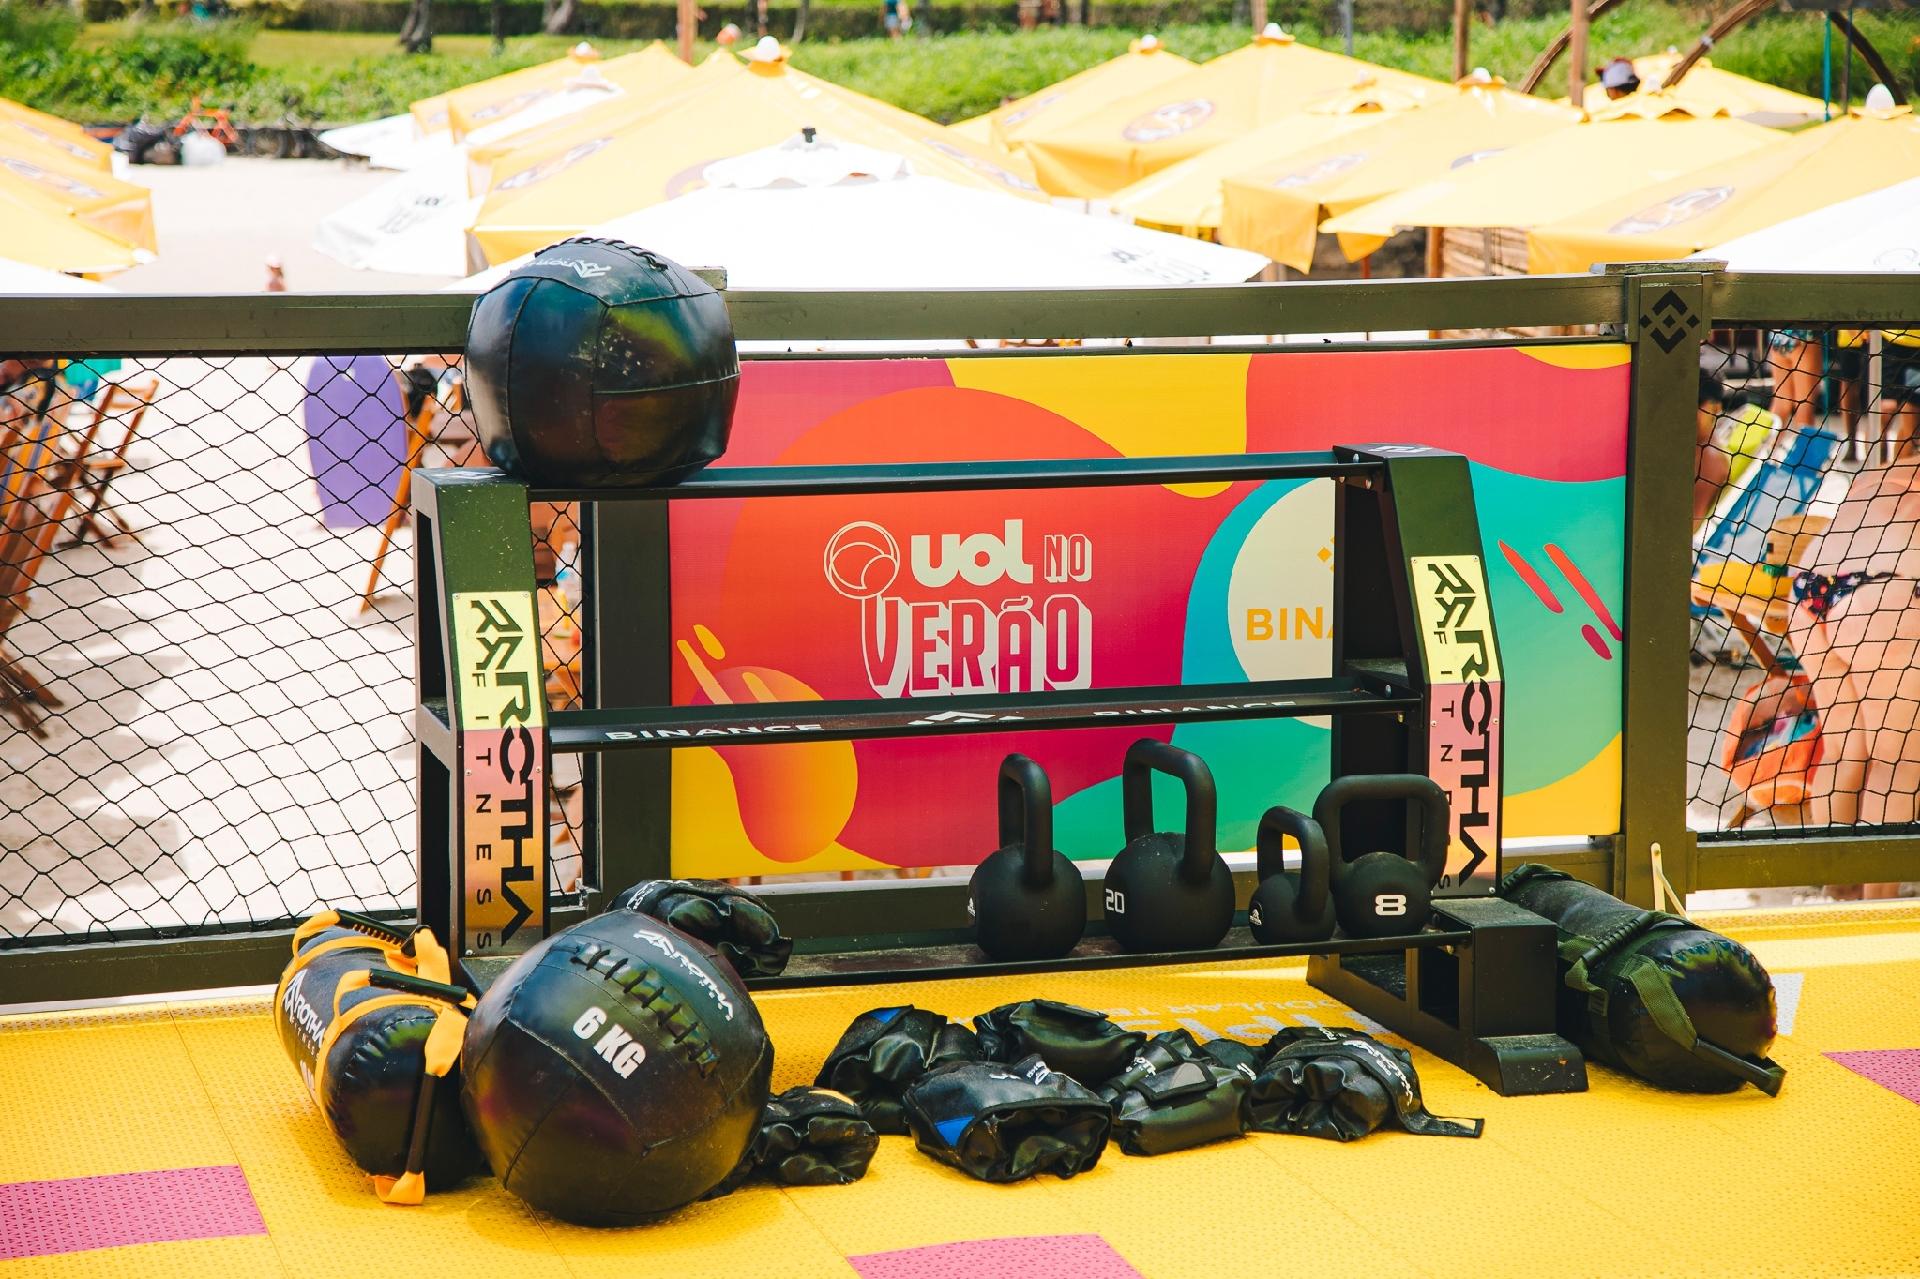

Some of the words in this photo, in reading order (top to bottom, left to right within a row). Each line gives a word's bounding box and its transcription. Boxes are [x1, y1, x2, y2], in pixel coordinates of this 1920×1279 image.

[1044, 534, 1092, 582] NO
[861, 594, 1092, 698] VERÃO
[1246, 607, 1334, 641] BIN
[605, 724, 824, 740] BINANCE
[1433, 631, 1455, 890] FITNS
[1456, 630, 1492, 887] ROTHA
[471, 673, 492, 950] FITNESS
[496, 672, 535, 947] ROTHA
[1105, 888, 1125, 914] 20
[1375, 894, 1407, 916] 8
[573, 1006, 607, 1040] 6
[593, 1024, 646, 1079] KG
